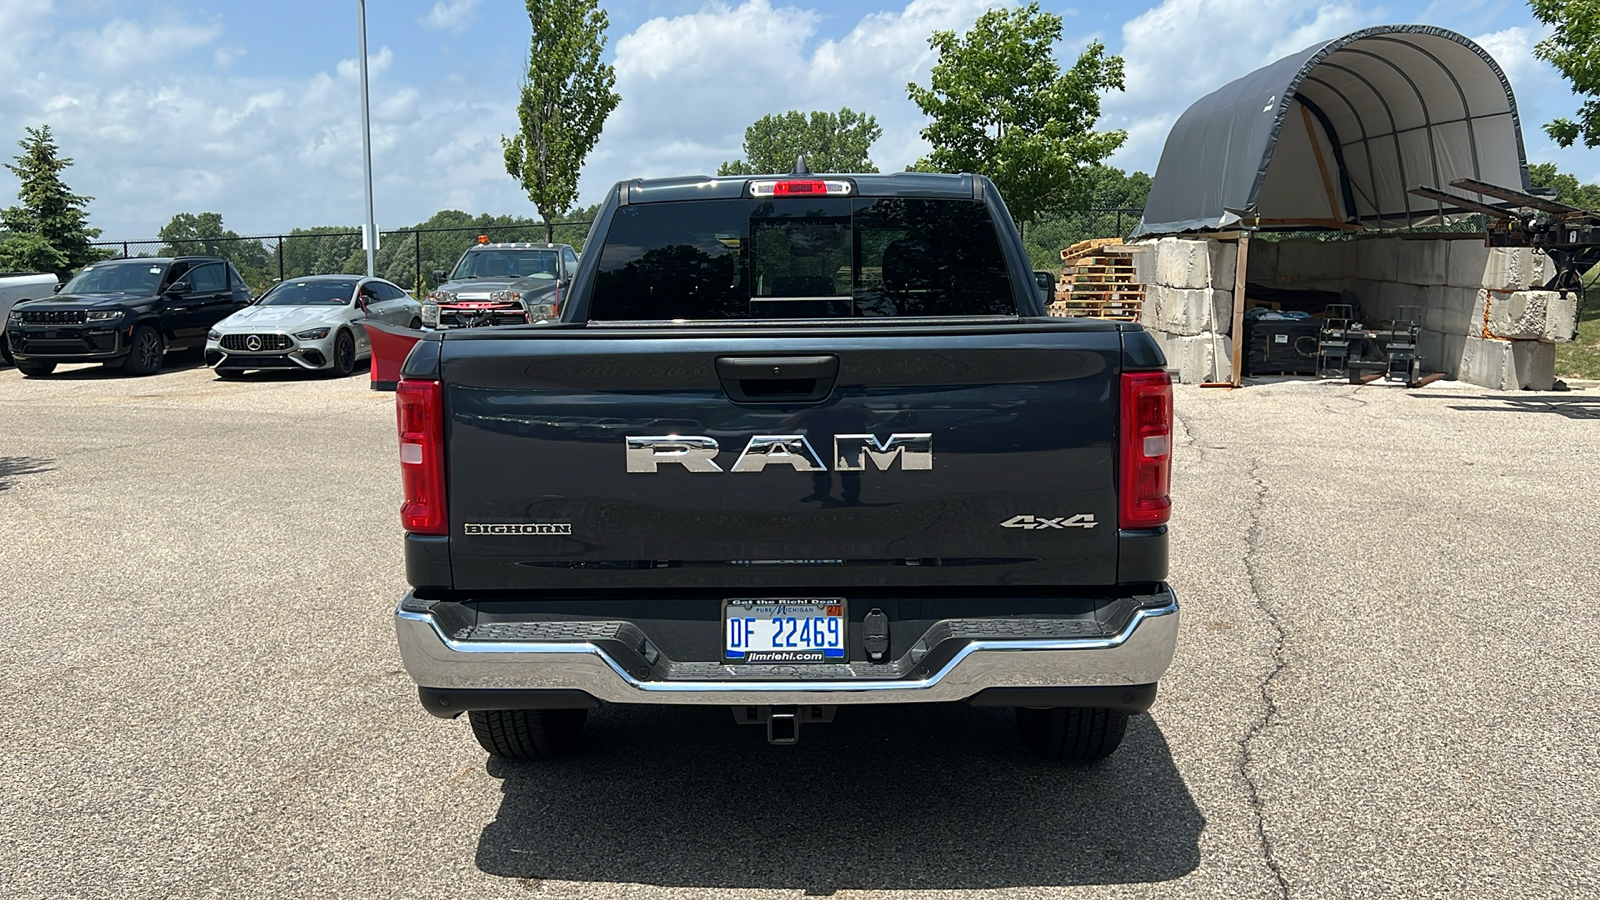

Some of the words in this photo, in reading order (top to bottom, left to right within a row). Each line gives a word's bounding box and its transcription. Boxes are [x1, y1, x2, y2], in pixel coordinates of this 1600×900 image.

[625, 433, 933, 473] RAM
[464, 523, 572, 535] BIGHORN
[730, 617, 756, 648] DF
[772, 616, 839, 648] 22469
[748, 652, 823, 663] jimriehl.com
